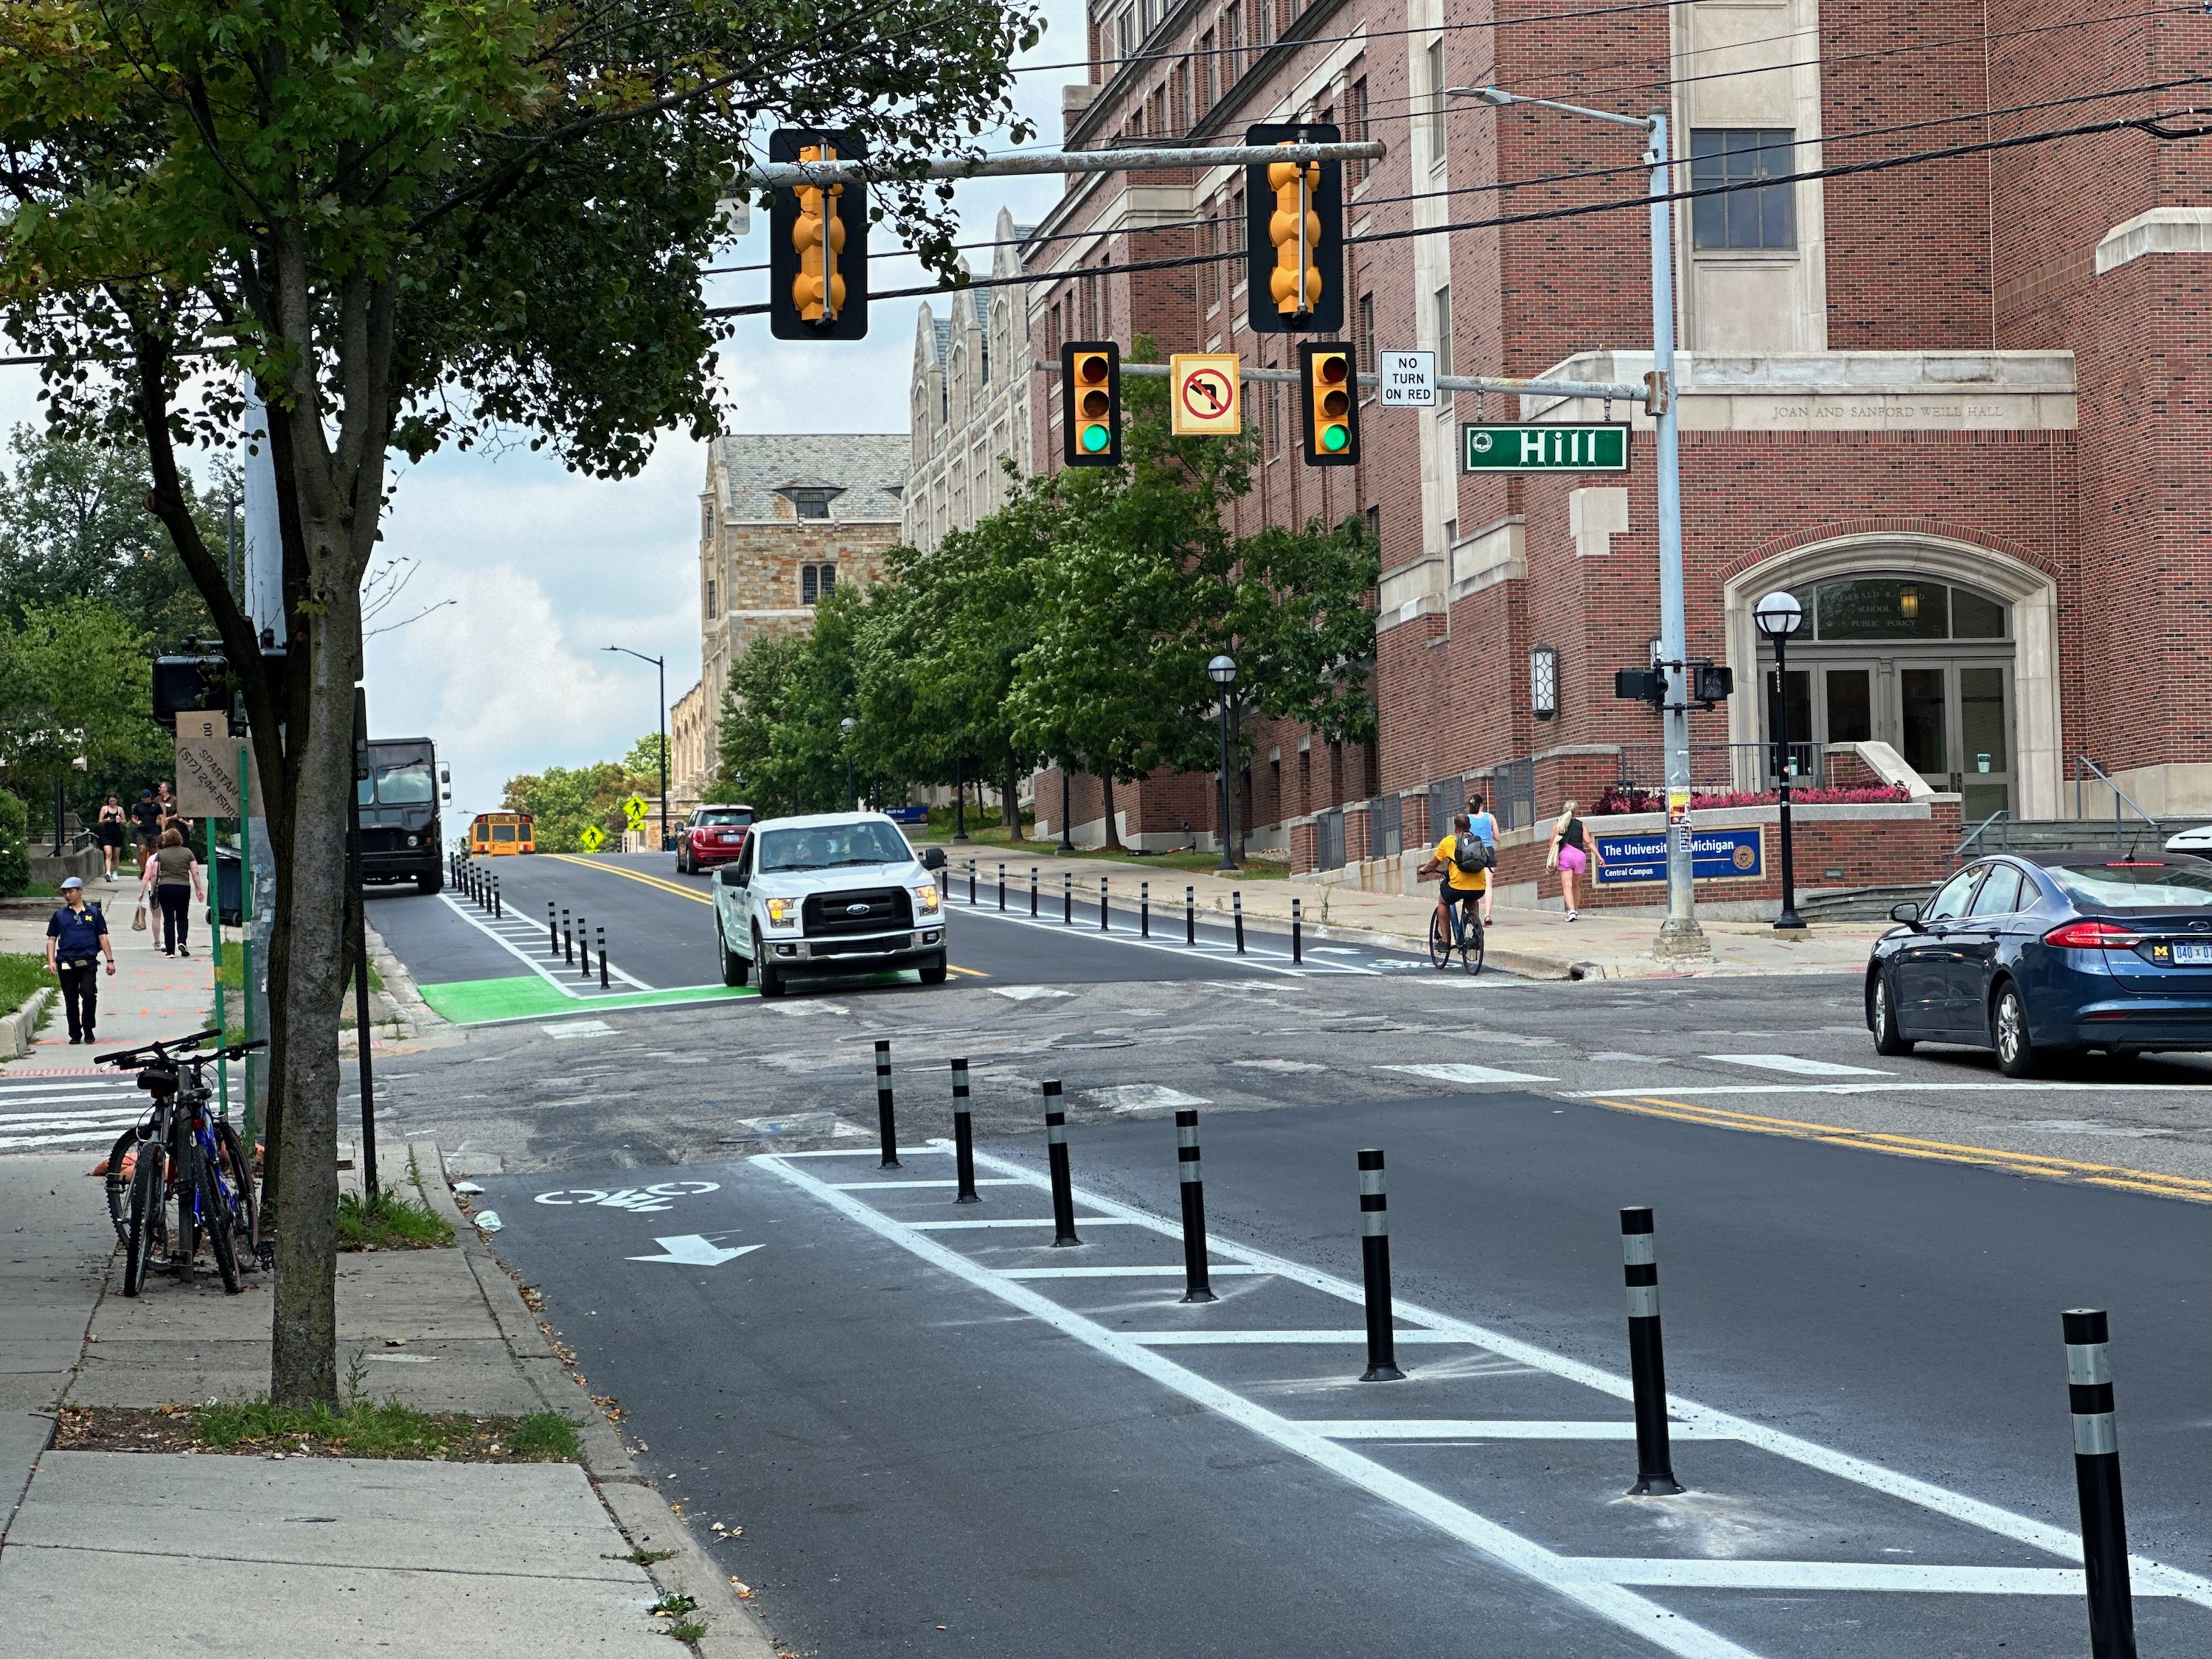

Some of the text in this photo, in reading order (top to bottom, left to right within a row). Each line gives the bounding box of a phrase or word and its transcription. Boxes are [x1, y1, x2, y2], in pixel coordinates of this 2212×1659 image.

[1399, 358, 1417, 369] NO
[1392, 373, 1424, 383] TURN
[1386, 389, 1430, 399] ON RED
[1773, 406, 2003, 420] JOAN AND SANFORD WEILL HALL
[1520, 430, 1596, 465] Hill
[1888, 619, 1916, 627] POLICY
[199, 749, 239, 796] SPARTAN
[178, 747, 235, 816] (517) 244-1500
[1604, 839, 1734, 857] The Universit Michigan
[1604, 868, 1653, 877] Central Campus
[2154, 946, 2168, 956] M
[2177, 947, 2193, 958] 040
